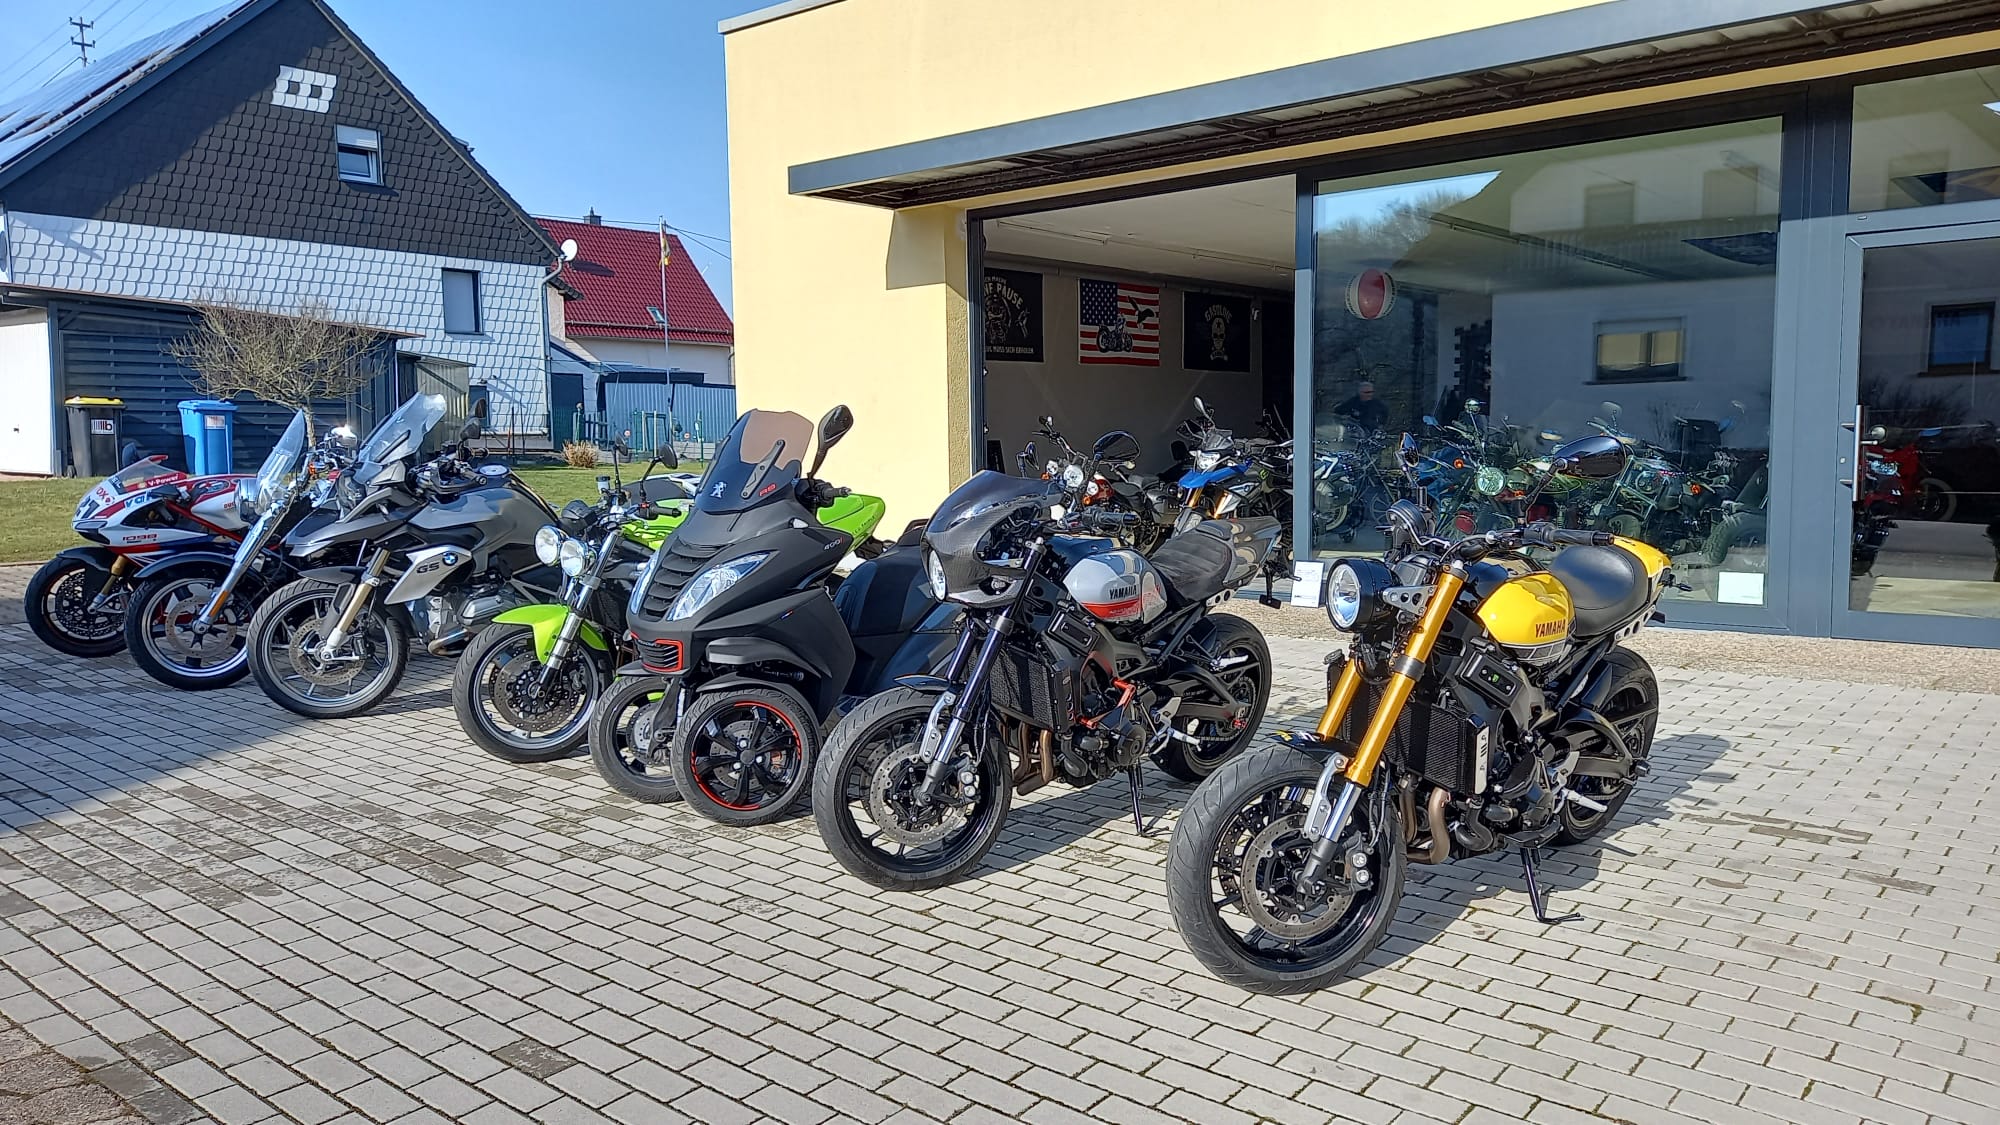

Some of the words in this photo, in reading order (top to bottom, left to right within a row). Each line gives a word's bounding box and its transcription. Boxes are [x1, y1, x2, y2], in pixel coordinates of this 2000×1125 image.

[996, 282, 1024, 310] PAUSE
[122, 533, 157, 541] 1098
[416, 562, 440, 574] GS
[1109, 584, 1137, 600] YAMAHA
[1535, 618, 1567, 639] YAMAHA
